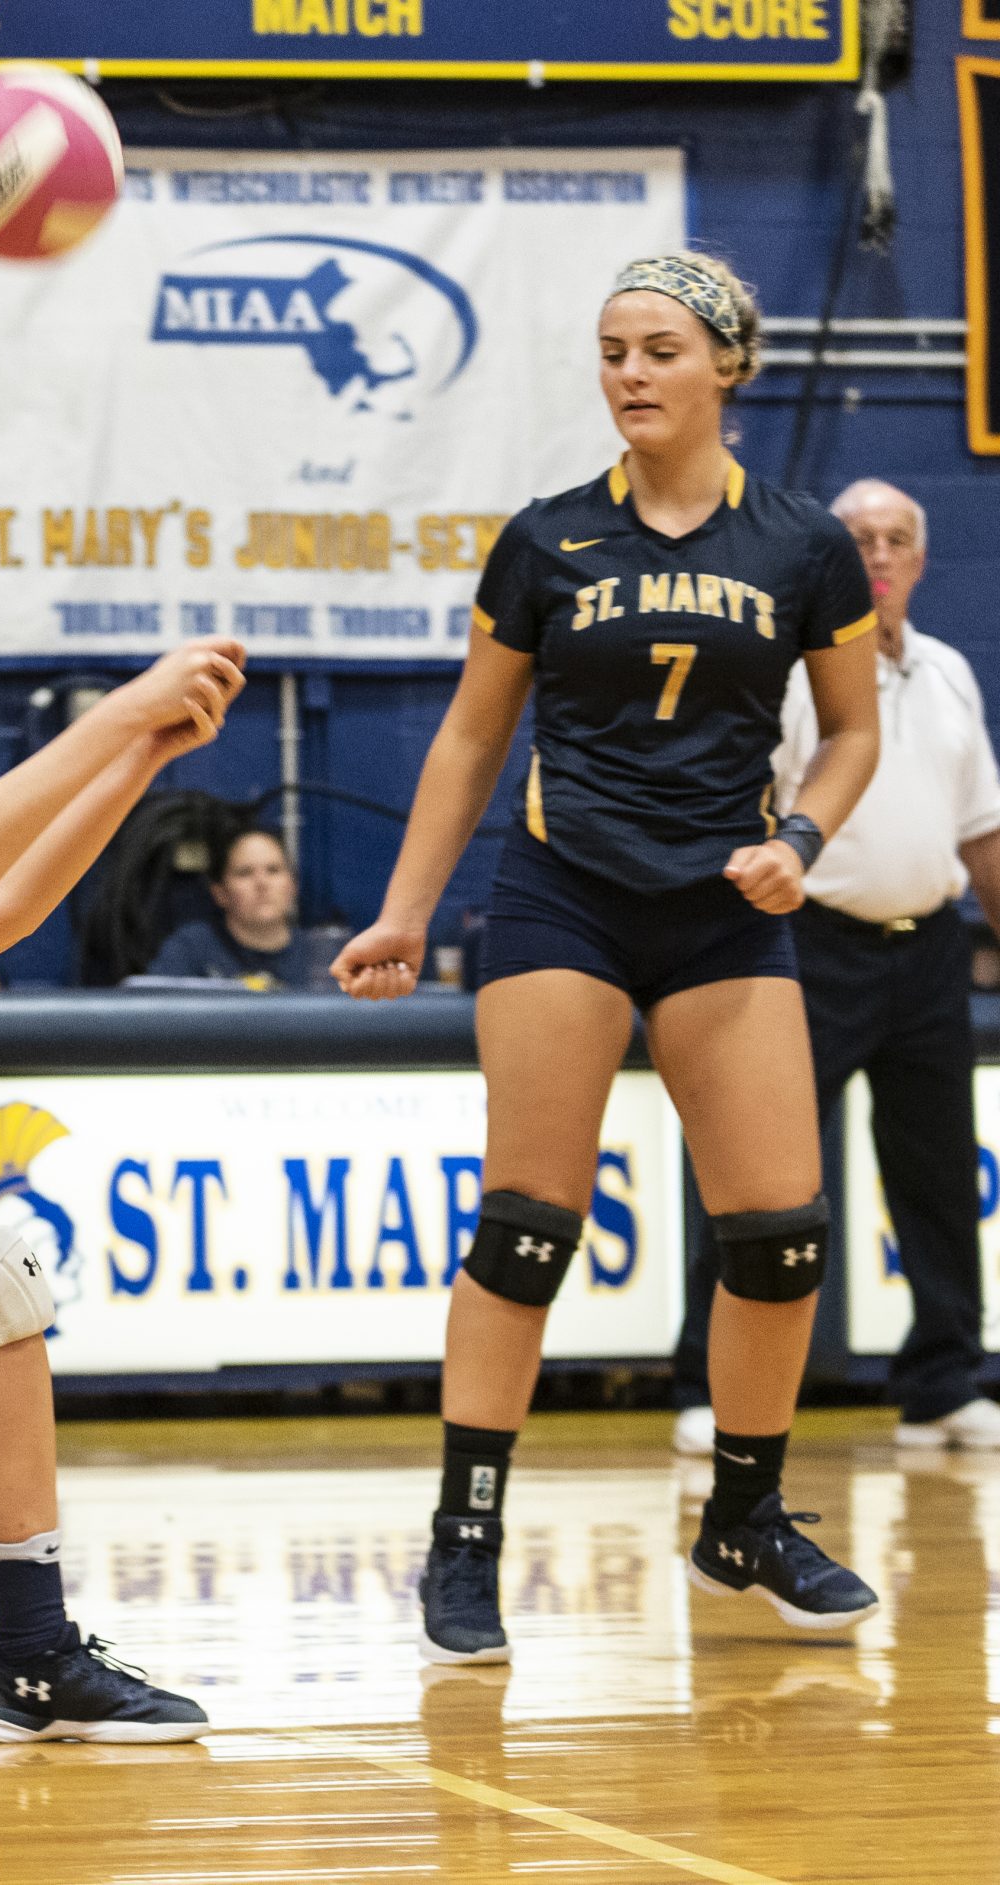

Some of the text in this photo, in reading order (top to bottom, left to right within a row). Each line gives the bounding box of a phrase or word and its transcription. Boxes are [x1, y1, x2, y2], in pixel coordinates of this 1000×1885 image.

[252, 0, 423, 36] MATCH
[667, 0, 828, 39] SCORE
[163, 287, 325, 332] MIAA
[42, 501, 212, 569] MARY'S
[571, 573, 776, 641] ST. MARY'S
[650, 643, 698, 721] 7
[108, 1157, 249, 1297] ST.
